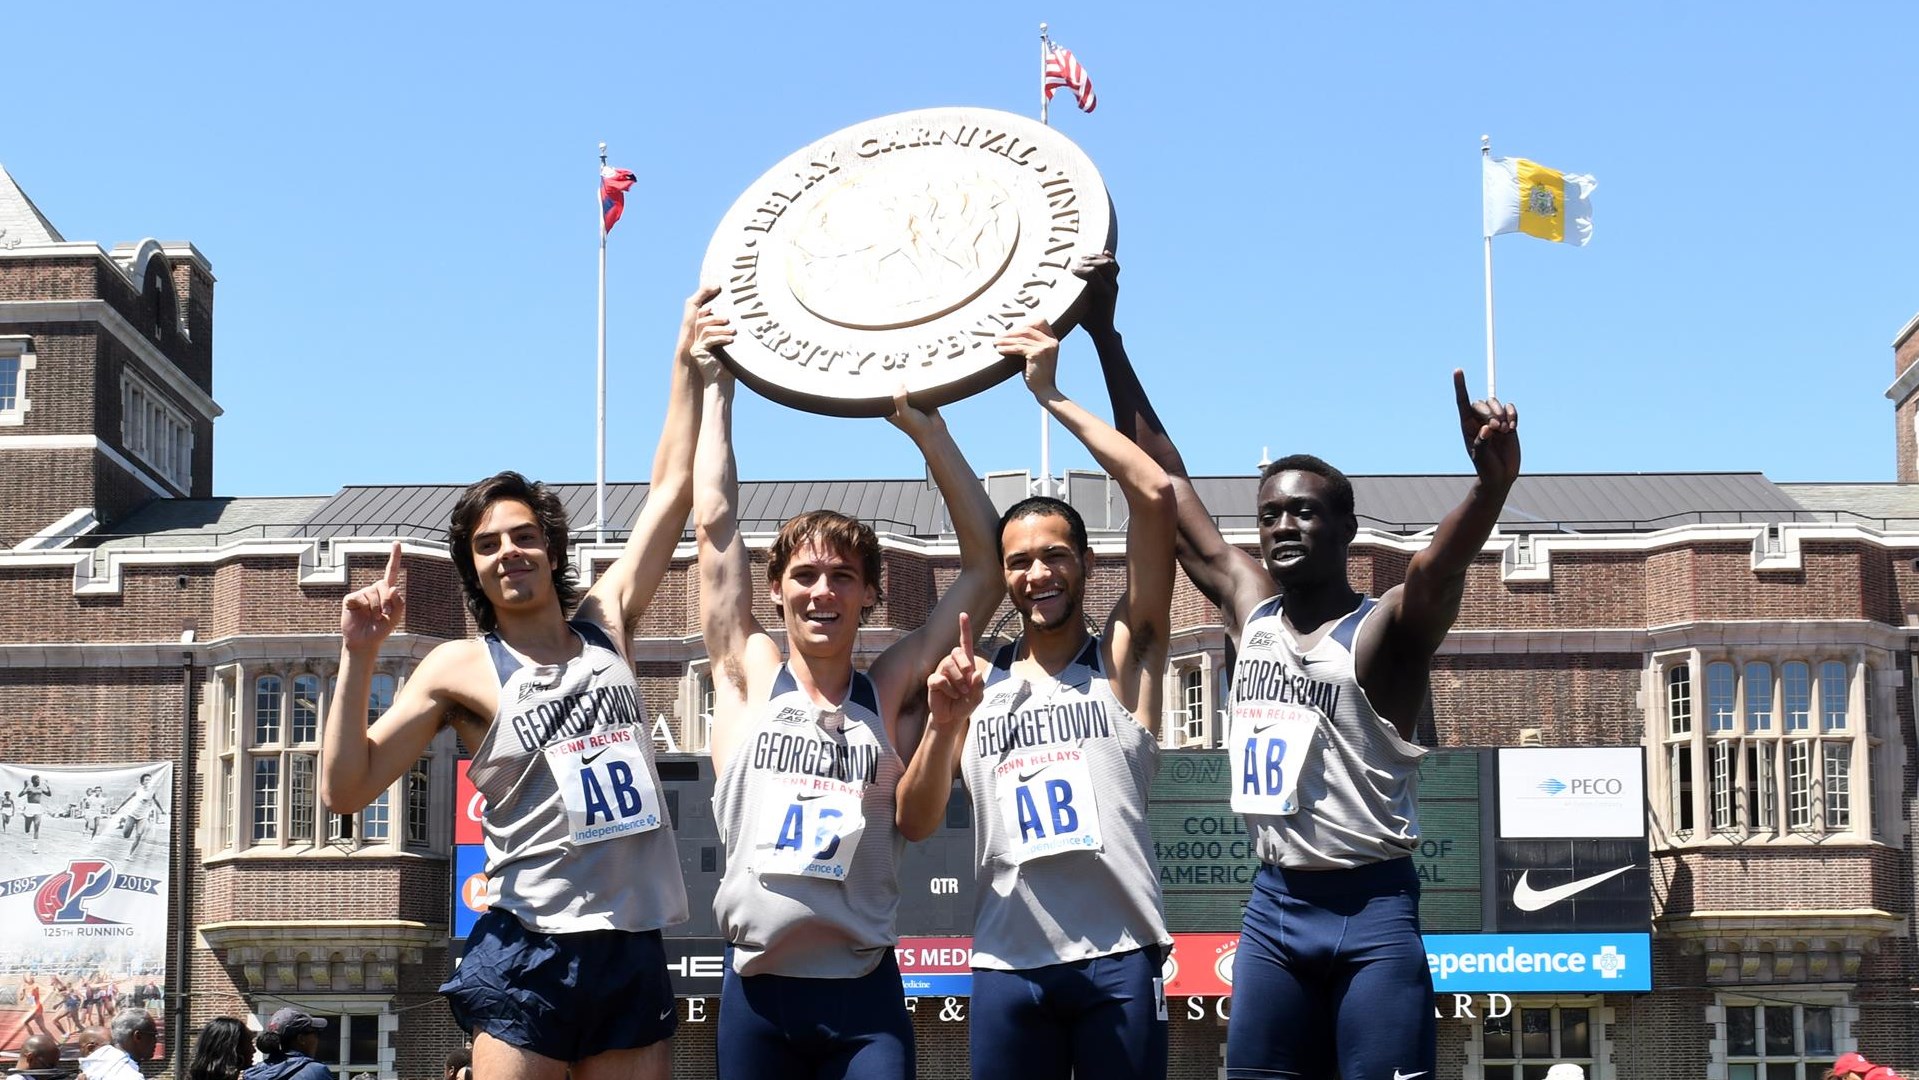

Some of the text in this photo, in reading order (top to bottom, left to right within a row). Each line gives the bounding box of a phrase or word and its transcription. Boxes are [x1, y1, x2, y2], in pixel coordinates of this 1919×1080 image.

[744, 126, 1038, 233] RELAY CARNIVAL
[730, 251, 876, 375] UNIVERSITY
[917, 171, 1080, 367] PENNSYLVANIA
[512, 685, 642, 752] GEORGETOWN
[976, 700, 1110, 758] GEORGETOWN
[588, 731, 631, 748] RELAYS
[754, 732, 878, 784] GEORGETOWN
[997, 750, 1080, 778] PENN RELAYS
[1242, 737, 1287, 796] AB
[579, 760, 642, 826] AB
[1571, 779, 1622, 795] PECO
[1015, 778, 1079, 844] AB
[1184, 817, 1247, 835] COLL
[574, 817, 646, 842] Independence
[1421, 840, 1453, 858] OF
[7, 876, 38, 895] 1895
[120, 875, 152, 892] 2019
[930, 877, 959, 895] QTR
[44, 927, 134, 937] 125TH RUNNING
[1427, 946, 1586, 979] ependence
